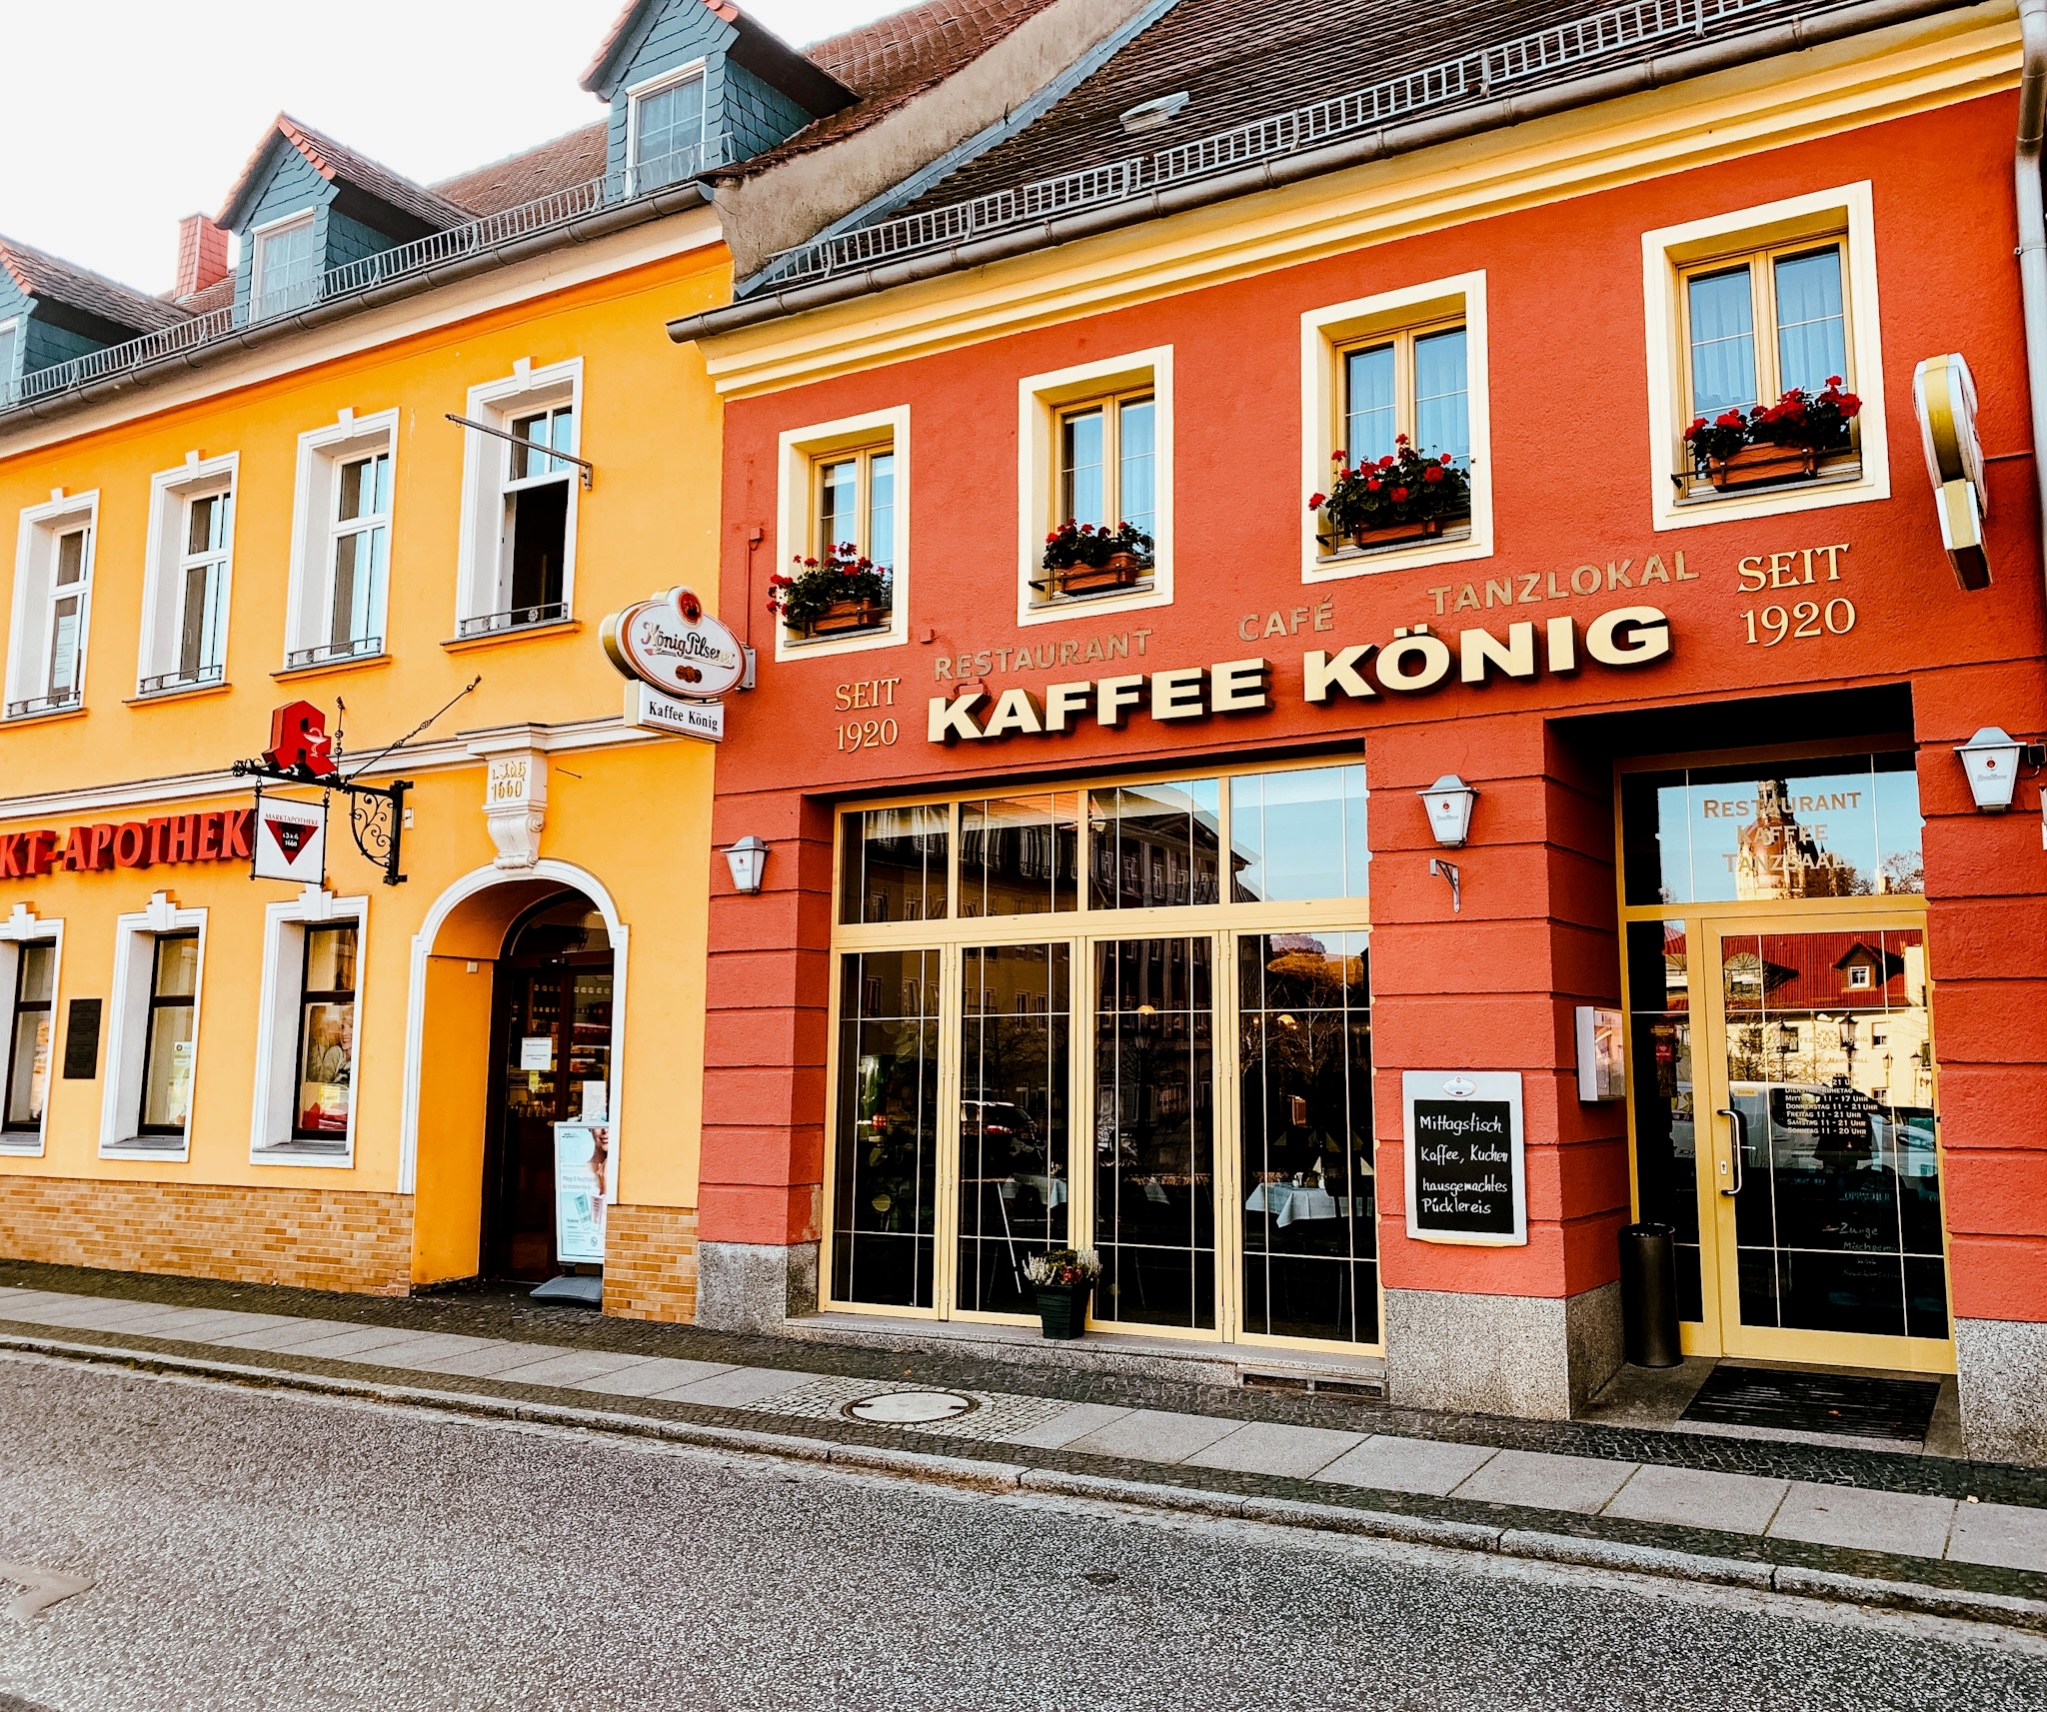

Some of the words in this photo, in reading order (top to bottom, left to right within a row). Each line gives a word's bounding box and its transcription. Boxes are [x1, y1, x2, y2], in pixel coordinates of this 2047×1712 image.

[1737, 543, 1850, 593] SEIT
[1427, 551, 1700, 615] TANZLOKAL
[1238, 593, 1334, 642] CAFÉ
[1739, 597, 1857, 648] 1920
[640, 620, 686, 658] König
[933, 627, 1153, 682] RESTAURANT
[927, 657, 1268, 742] KAFFEE
[1302, 604, 1670, 703] KÖNIG
[834, 677, 902, 712] SEIT
[648, 700, 685, 723] Kaffee
[688, 710, 718, 732] König
[835, 717, 900, 754] 1920
[490, 779, 523, 803] 1660
[1703, 792, 1862, 818] RESTAURANT
[1736, 823, 1829, 845] KAFFEE
[1722, 852, 1847, 873] TANZSAAL
[1852, 1095, 1869, 1103] UHR
[1863, 1103, 1878, 1111] UHR
[1419, 1112, 1503, 1136] Mittagstisch
[1850, 1119, 1866, 1127] UHR
[1421, 1143, 1465, 1166] Kaffee,
[1470, 1143, 1508, 1163] Kuchen
[1422, 1173, 1508, 1197] hausgemachtes
[1421, 1196, 1492, 1214] Pücklereis
